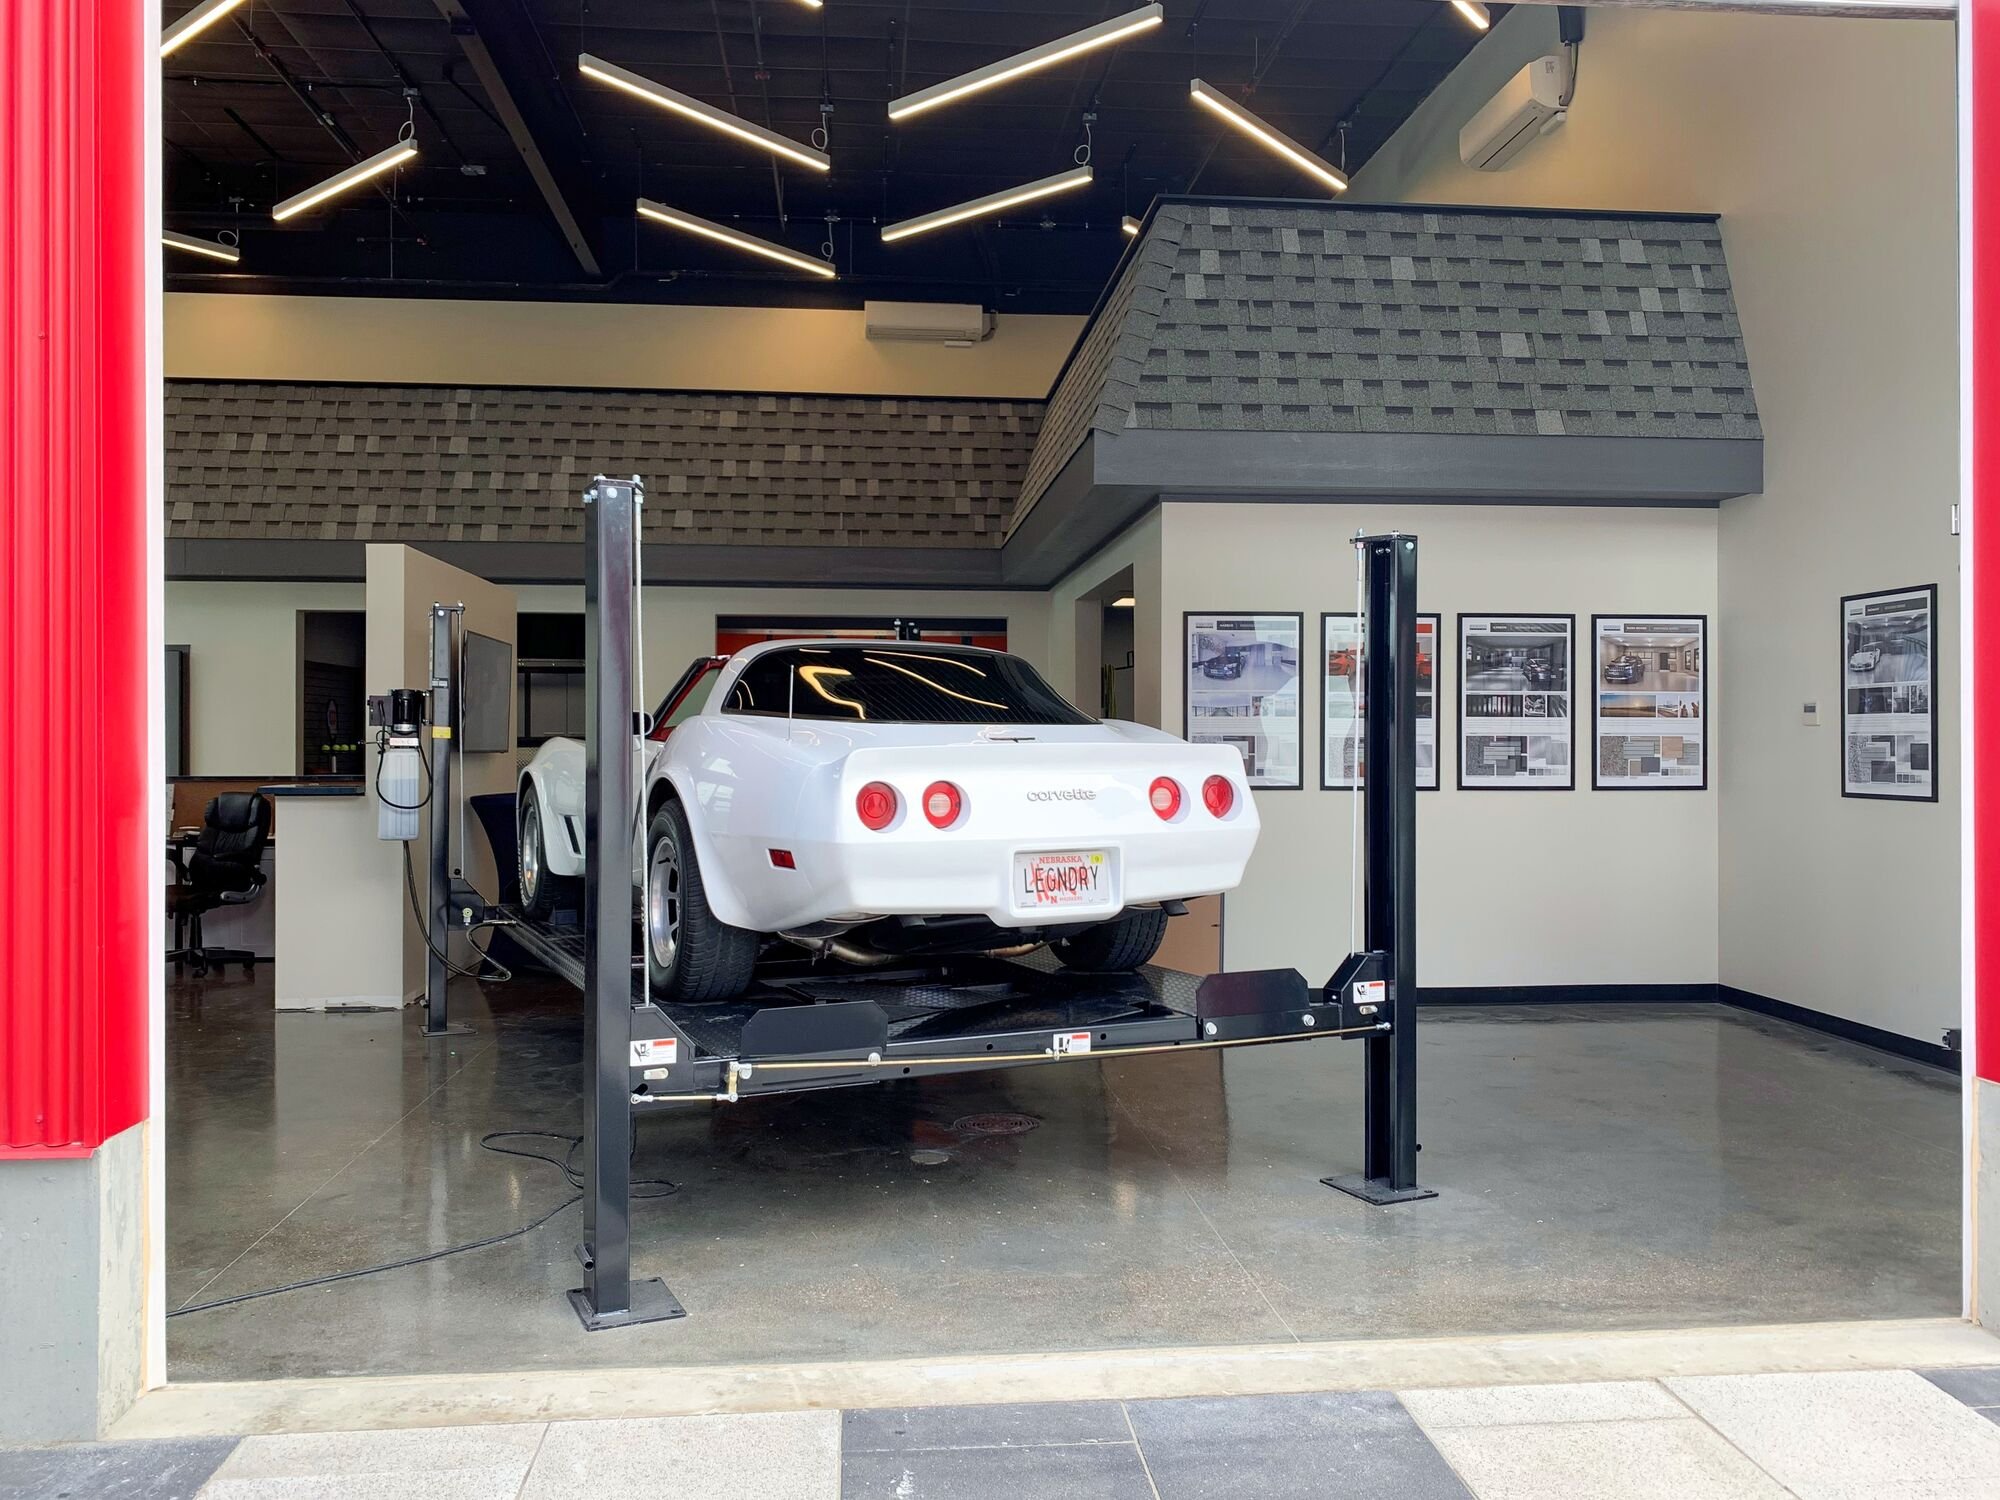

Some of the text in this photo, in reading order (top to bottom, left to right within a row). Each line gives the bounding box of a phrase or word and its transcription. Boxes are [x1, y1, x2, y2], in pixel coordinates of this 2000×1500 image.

[1026, 788, 1097, 802] corvette
[1039, 855, 1083, 864] NEBRASKA
[1023, 865, 1099, 894] LEGNDRY
